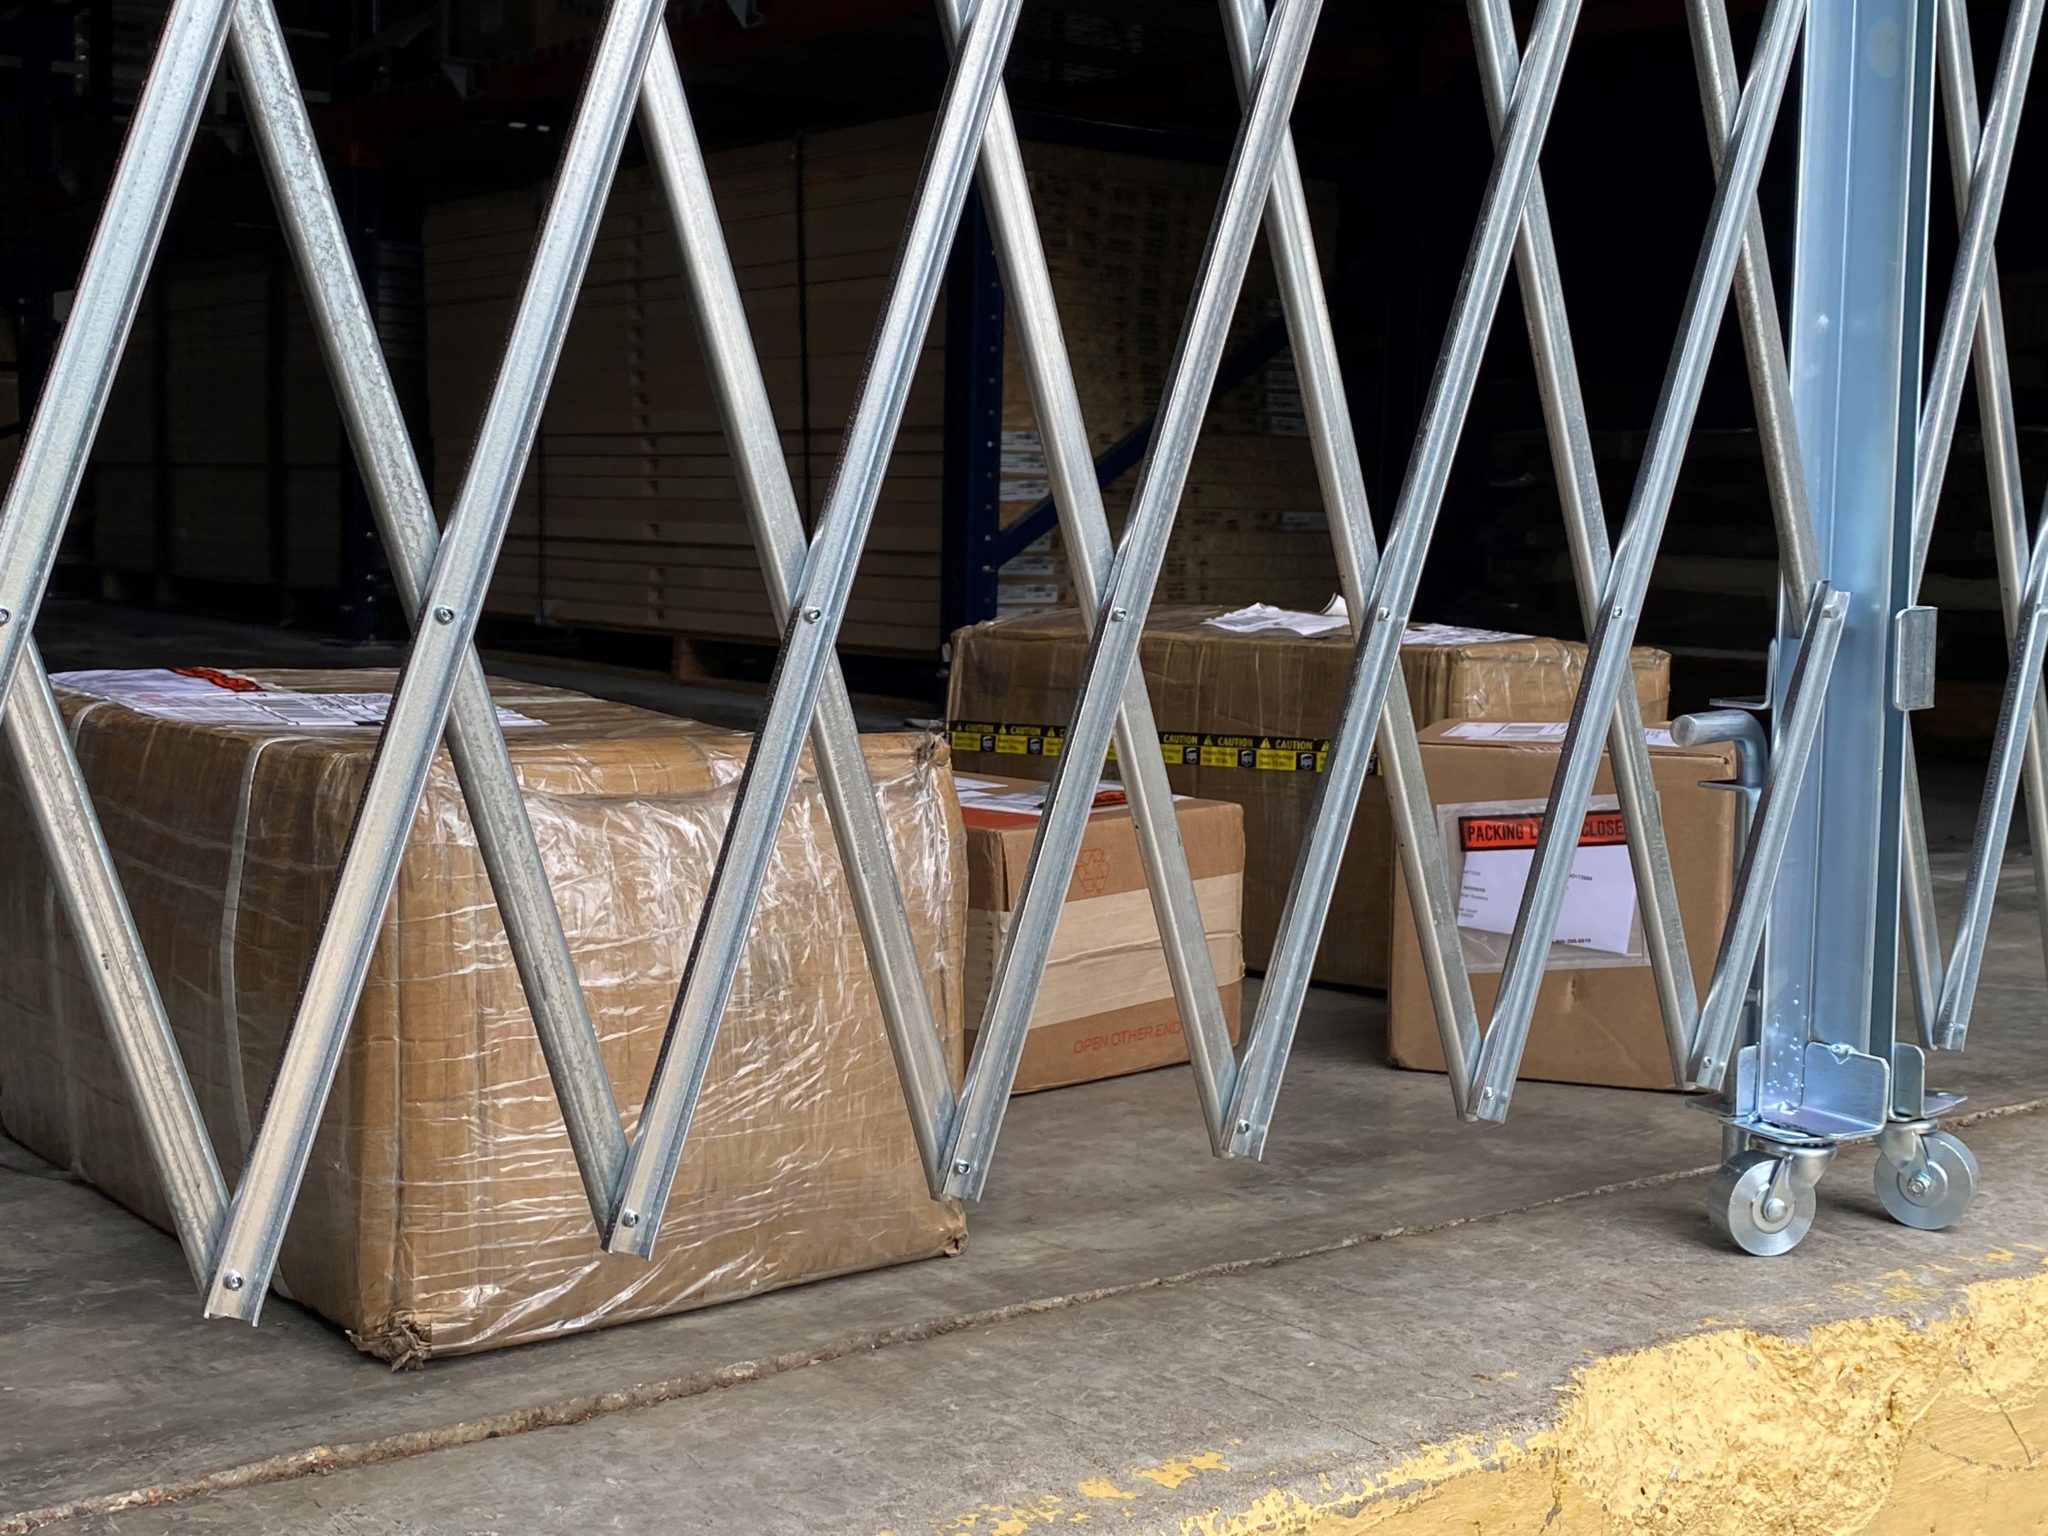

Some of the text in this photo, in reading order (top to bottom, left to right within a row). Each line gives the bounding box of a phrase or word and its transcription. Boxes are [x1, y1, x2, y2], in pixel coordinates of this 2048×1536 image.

[1163, 734, 1198, 745] CAUTION
[1217, 736, 1253, 747] CAUTION
[1275, 739, 1313, 750] CAUTION
[1467, 823, 1524, 842] PACKING
[1580, 819, 1625, 837] CLOSE
[1073, 1020, 1180, 1054] OPEN OTHER END
